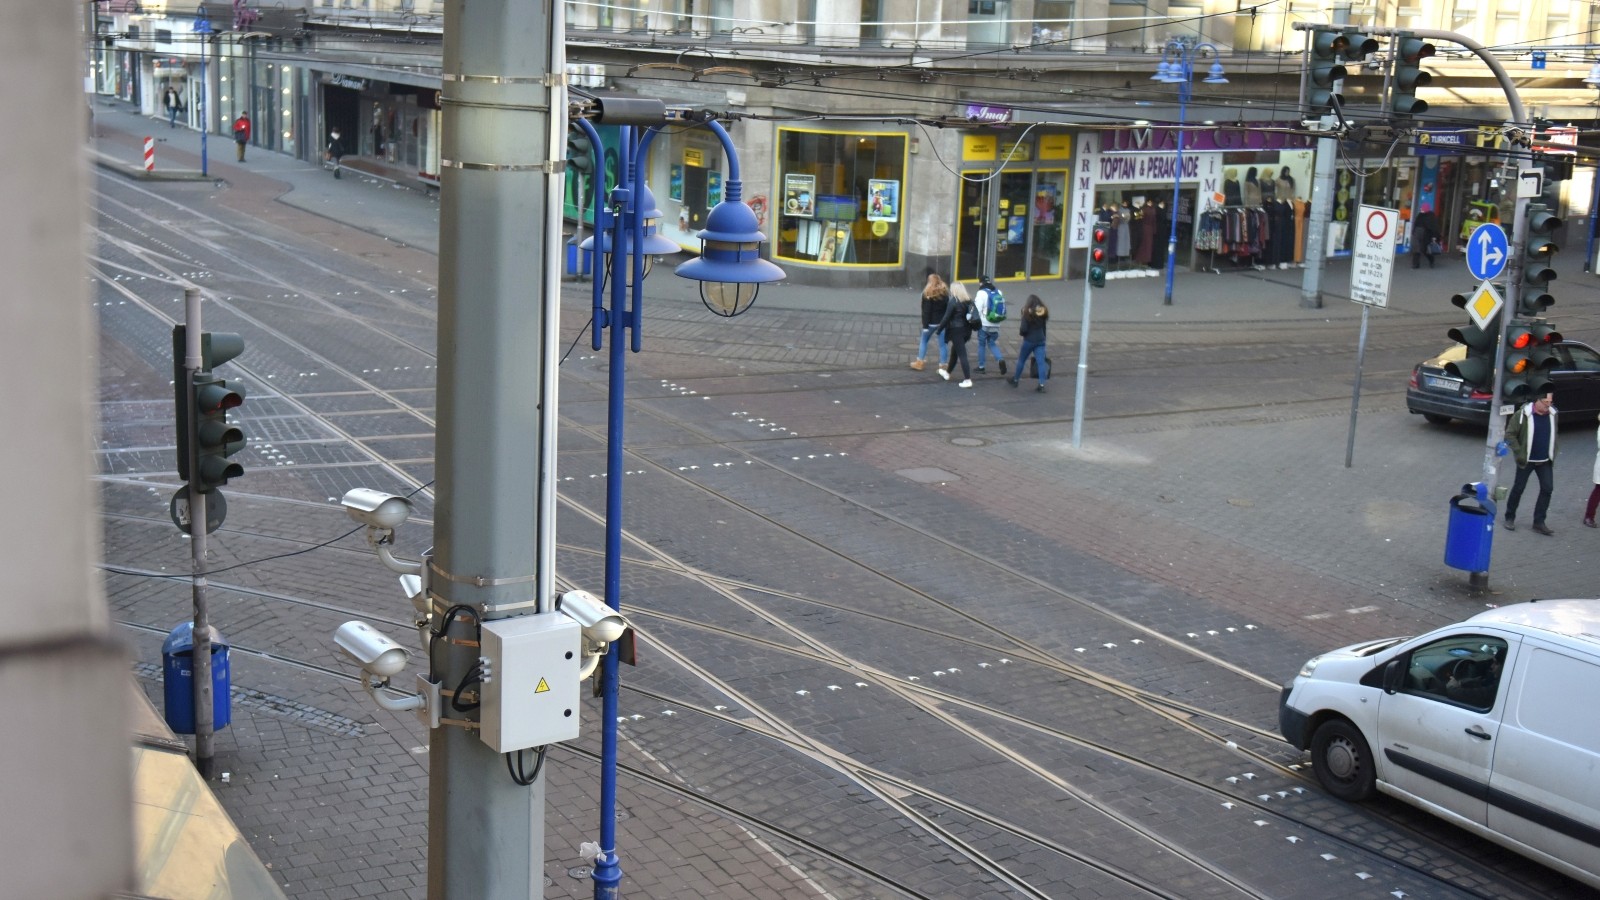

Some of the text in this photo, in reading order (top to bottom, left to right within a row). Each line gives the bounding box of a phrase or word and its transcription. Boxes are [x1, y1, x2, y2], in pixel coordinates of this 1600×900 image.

[978, 106, 1010, 122] Imaj
[1431, 135, 1460, 144] TURKCELL
[1100, 156, 1199, 180] TOPTAN & PERAKNDE
[1366, 240, 1383, 249] ZONE
